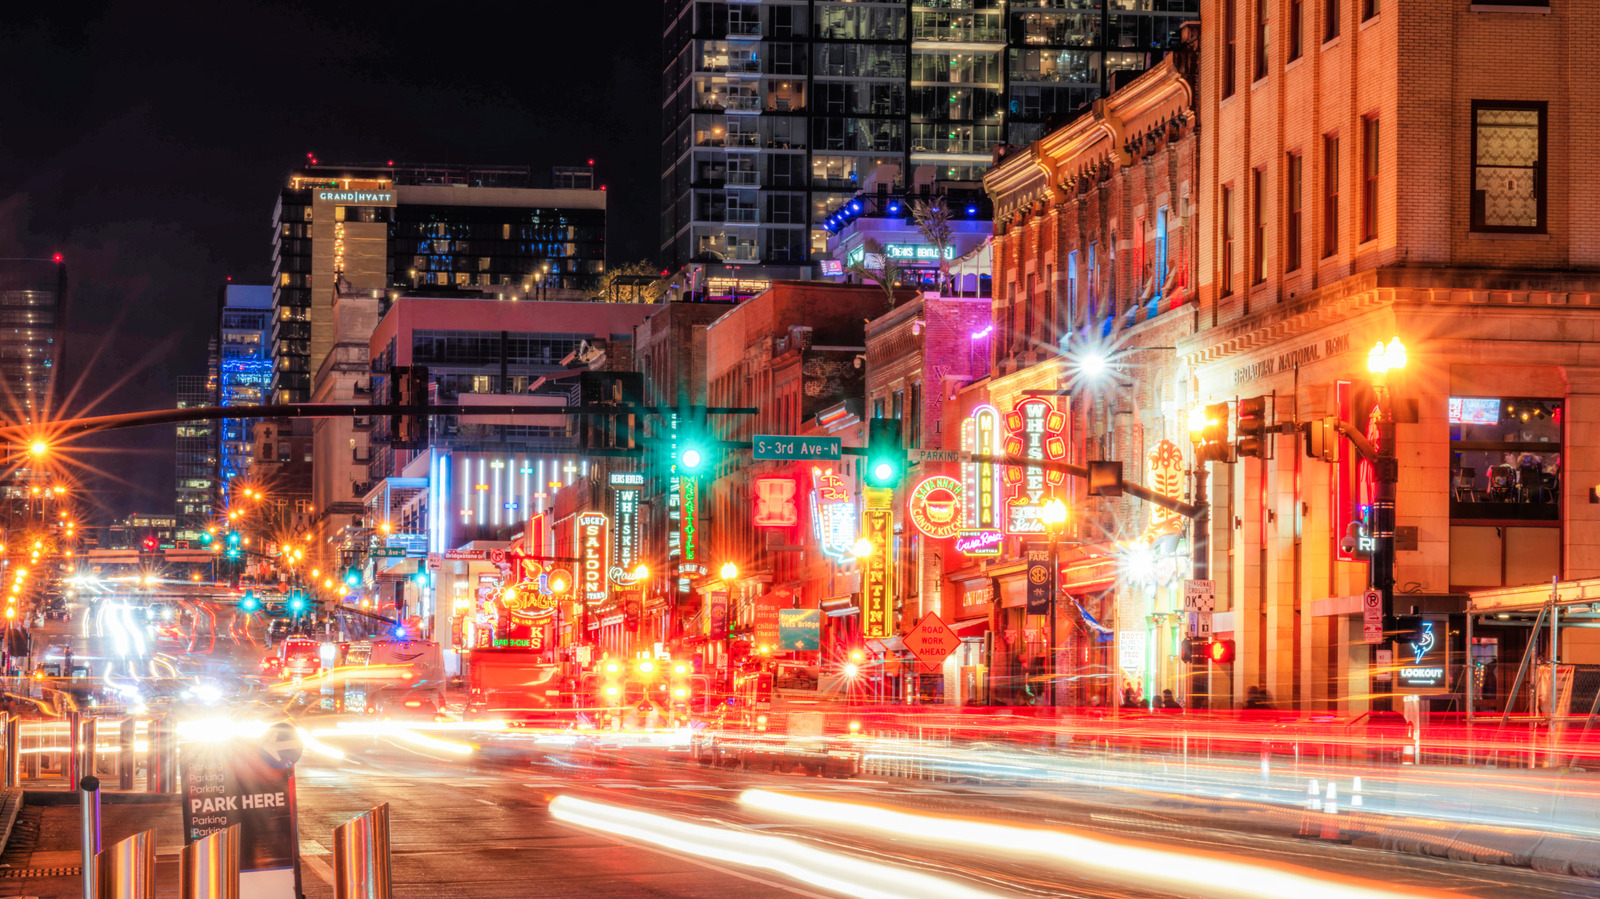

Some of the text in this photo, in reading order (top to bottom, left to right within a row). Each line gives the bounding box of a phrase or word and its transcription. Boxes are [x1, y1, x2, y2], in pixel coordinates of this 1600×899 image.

[320, 192, 391, 201] GRAND HYATT
[1233, 334, 1349, 385] BROADWAY NATIONAL BANK
[920, 451, 959, 462] PARKING
[820, 475, 844, 487] Tin
[819, 487, 850, 503] Roof
[580, 516, 606, 526] LUCKY
[913, 508, 937, 535] CANDY
[621, 491, 634, 568] WHISKEY
[956, 532, 1004, 552] Casa Rosa
[445, 552, 477, 560] Bridgestone
[586, 525, 600, 592] SALOON
[1029, 554, 1050, 562] FANS
[870, 519, 884, 637] VALENTINE
[1031, 568, 1046, 582] SEC
[1185, 596, 1197, 608] OK
[922, 626, 944, 634] ROAD
[922, 637, 944, 645] WORK
[919, 648, 946, 656] AHEAD
[1401, 669, 1443, 678] LOOKOUT
[189, 774, 224, 784] Parking
[190, 785, 225, 795] Parking
[191, 792, 285, 813] PARK HERE
[192, 816, 227, 826] Parking
